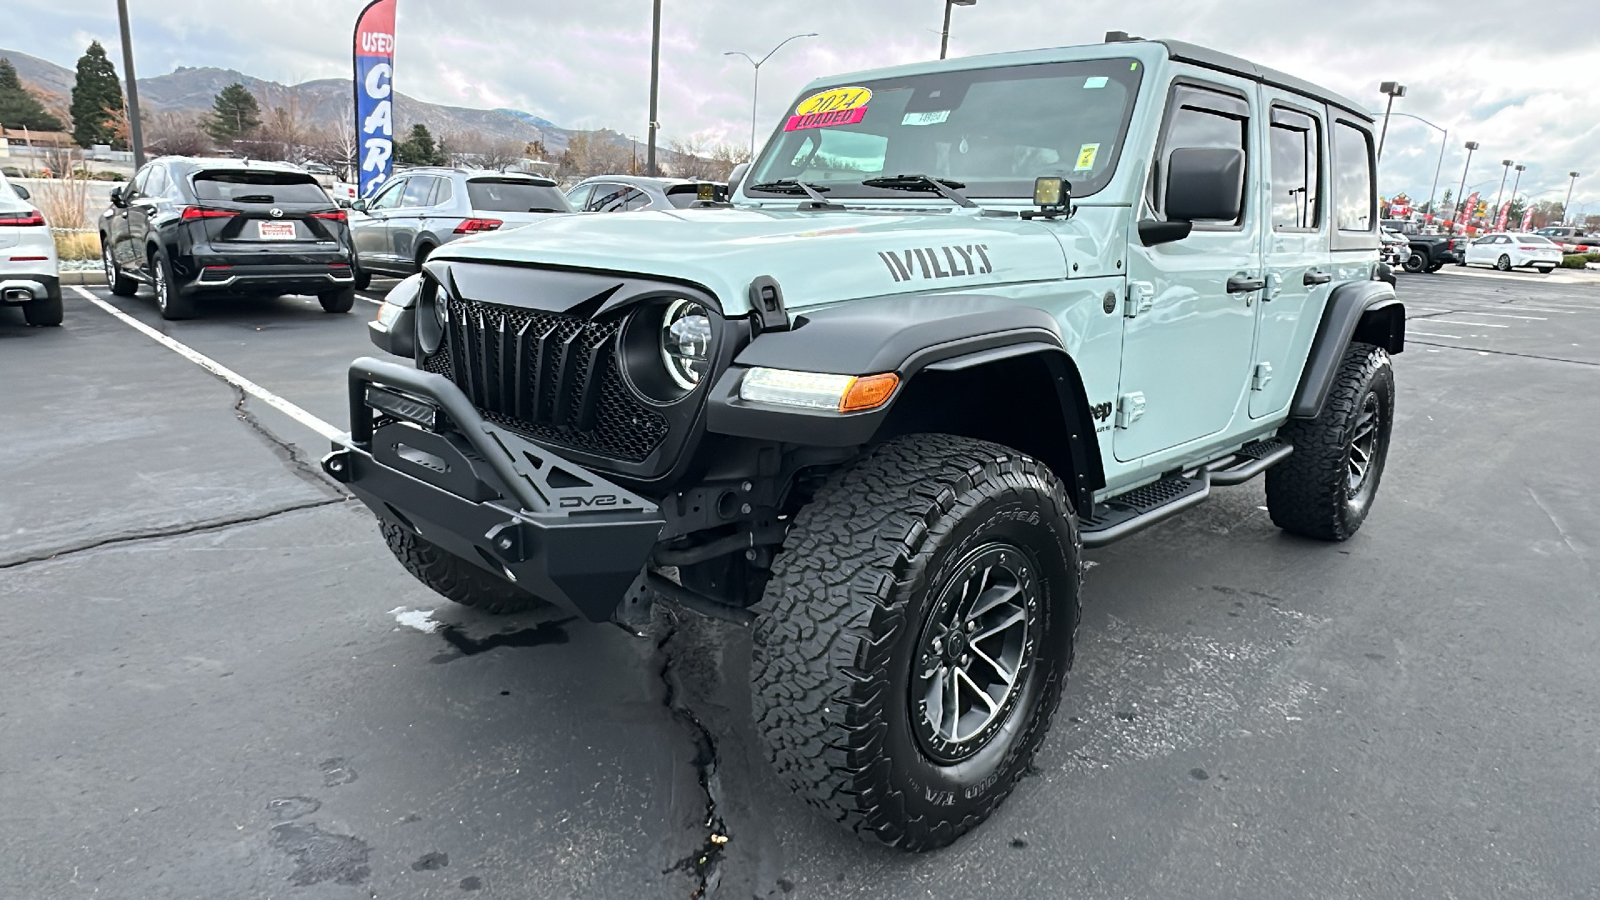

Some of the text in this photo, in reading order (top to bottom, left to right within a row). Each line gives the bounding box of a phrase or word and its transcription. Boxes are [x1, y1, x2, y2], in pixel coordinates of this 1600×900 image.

[362, 32, 394, 53] USED
[807, 91, 865, 114] 2024
[795, 109, 855, 128] LOADED
[877, 244, 992, 282] WILLYS
[1089, 401, 1113, 433] eep
